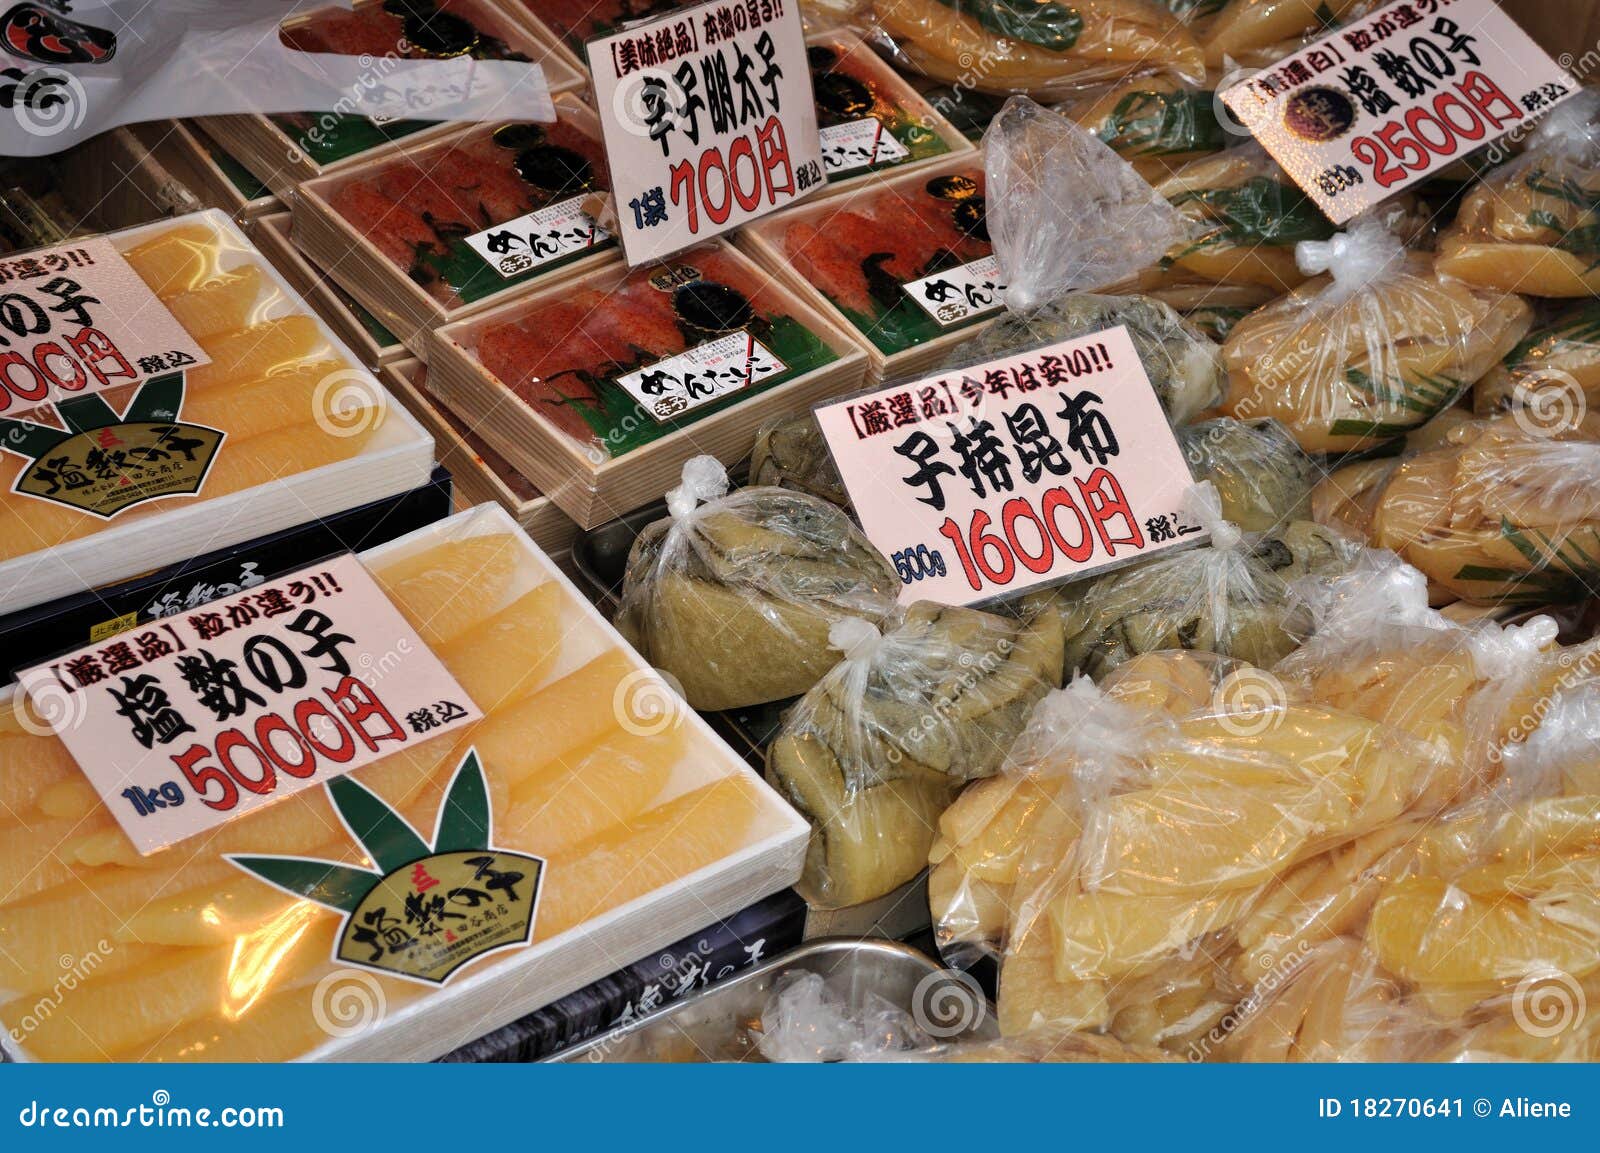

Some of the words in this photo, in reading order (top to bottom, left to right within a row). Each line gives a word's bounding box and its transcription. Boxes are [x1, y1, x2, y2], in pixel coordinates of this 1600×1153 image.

[641, 31, 784, 157] 辛子明太子
[1337, 16, 1482, 118] 塩数の子
[629, 187, 668, 229] 1袋
[669, 115, 796, 234] 700円
[796, 160, 822, 191] 税込
[1351, 70, 1524, 188] 2500円
[1520, 83, 1569, 112] 税込
[0, 276, 100, 347] の子
[0, 327, 138, 412] 00円
[136, 350, 197, 373] 税込
[893, 390, 1120, 511] 子持昆布
[891, 543, 947, 584] 500g
[939, 467, 1145, 591] 1600円
[106, 609, 356, 750] 塩数の子
[121, 780, 185, 816] 1kg
[169, 675, 408, 811] 5000円
[405, 700, 469, 734] 税込
